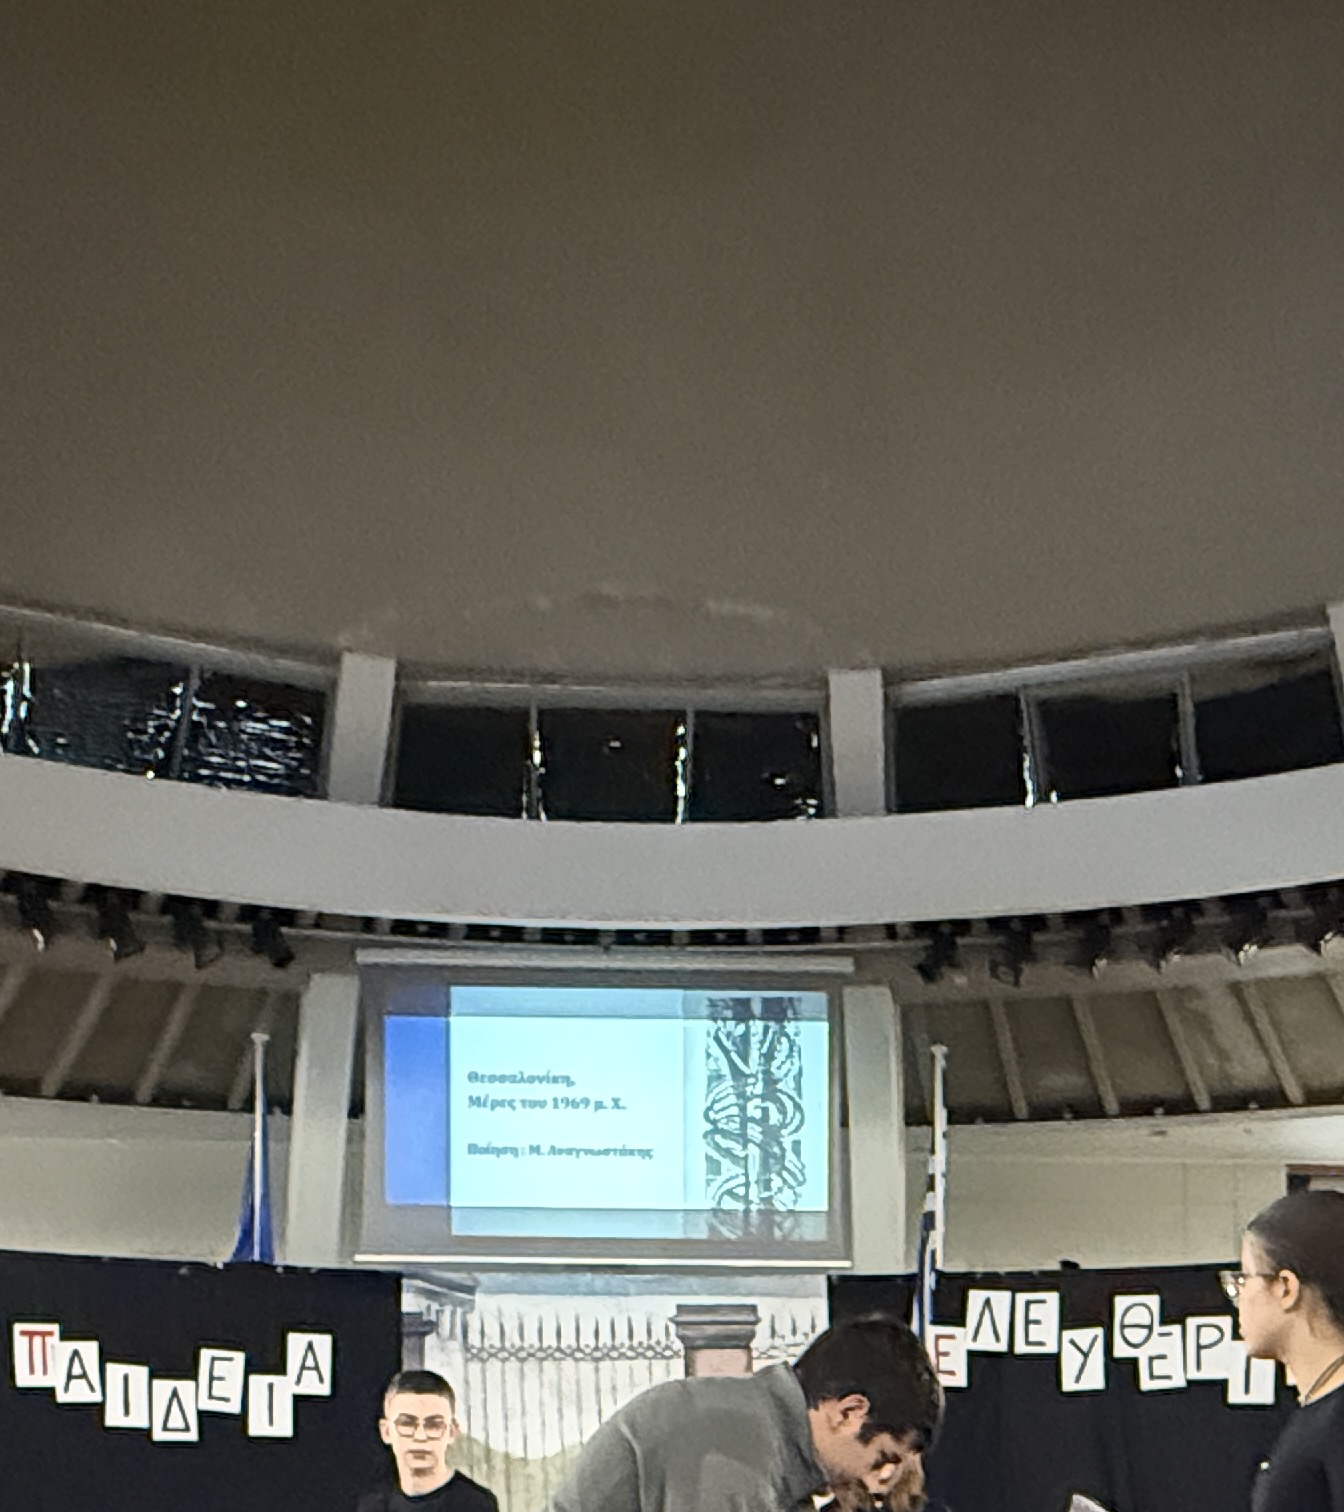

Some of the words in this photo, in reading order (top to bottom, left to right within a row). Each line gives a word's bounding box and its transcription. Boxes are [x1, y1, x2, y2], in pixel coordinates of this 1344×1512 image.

[468, 1094, 516, 1111] Μέρες
[520, 1099, 548, 1109] του
[552, 1096, 591, 1109] 1969
[19, 1330, 324, 1434] ΠΑΙΔΕΙΑ
[934, 1296, 1252, 1396] ΕΛΕΥΘΕΡΙ
